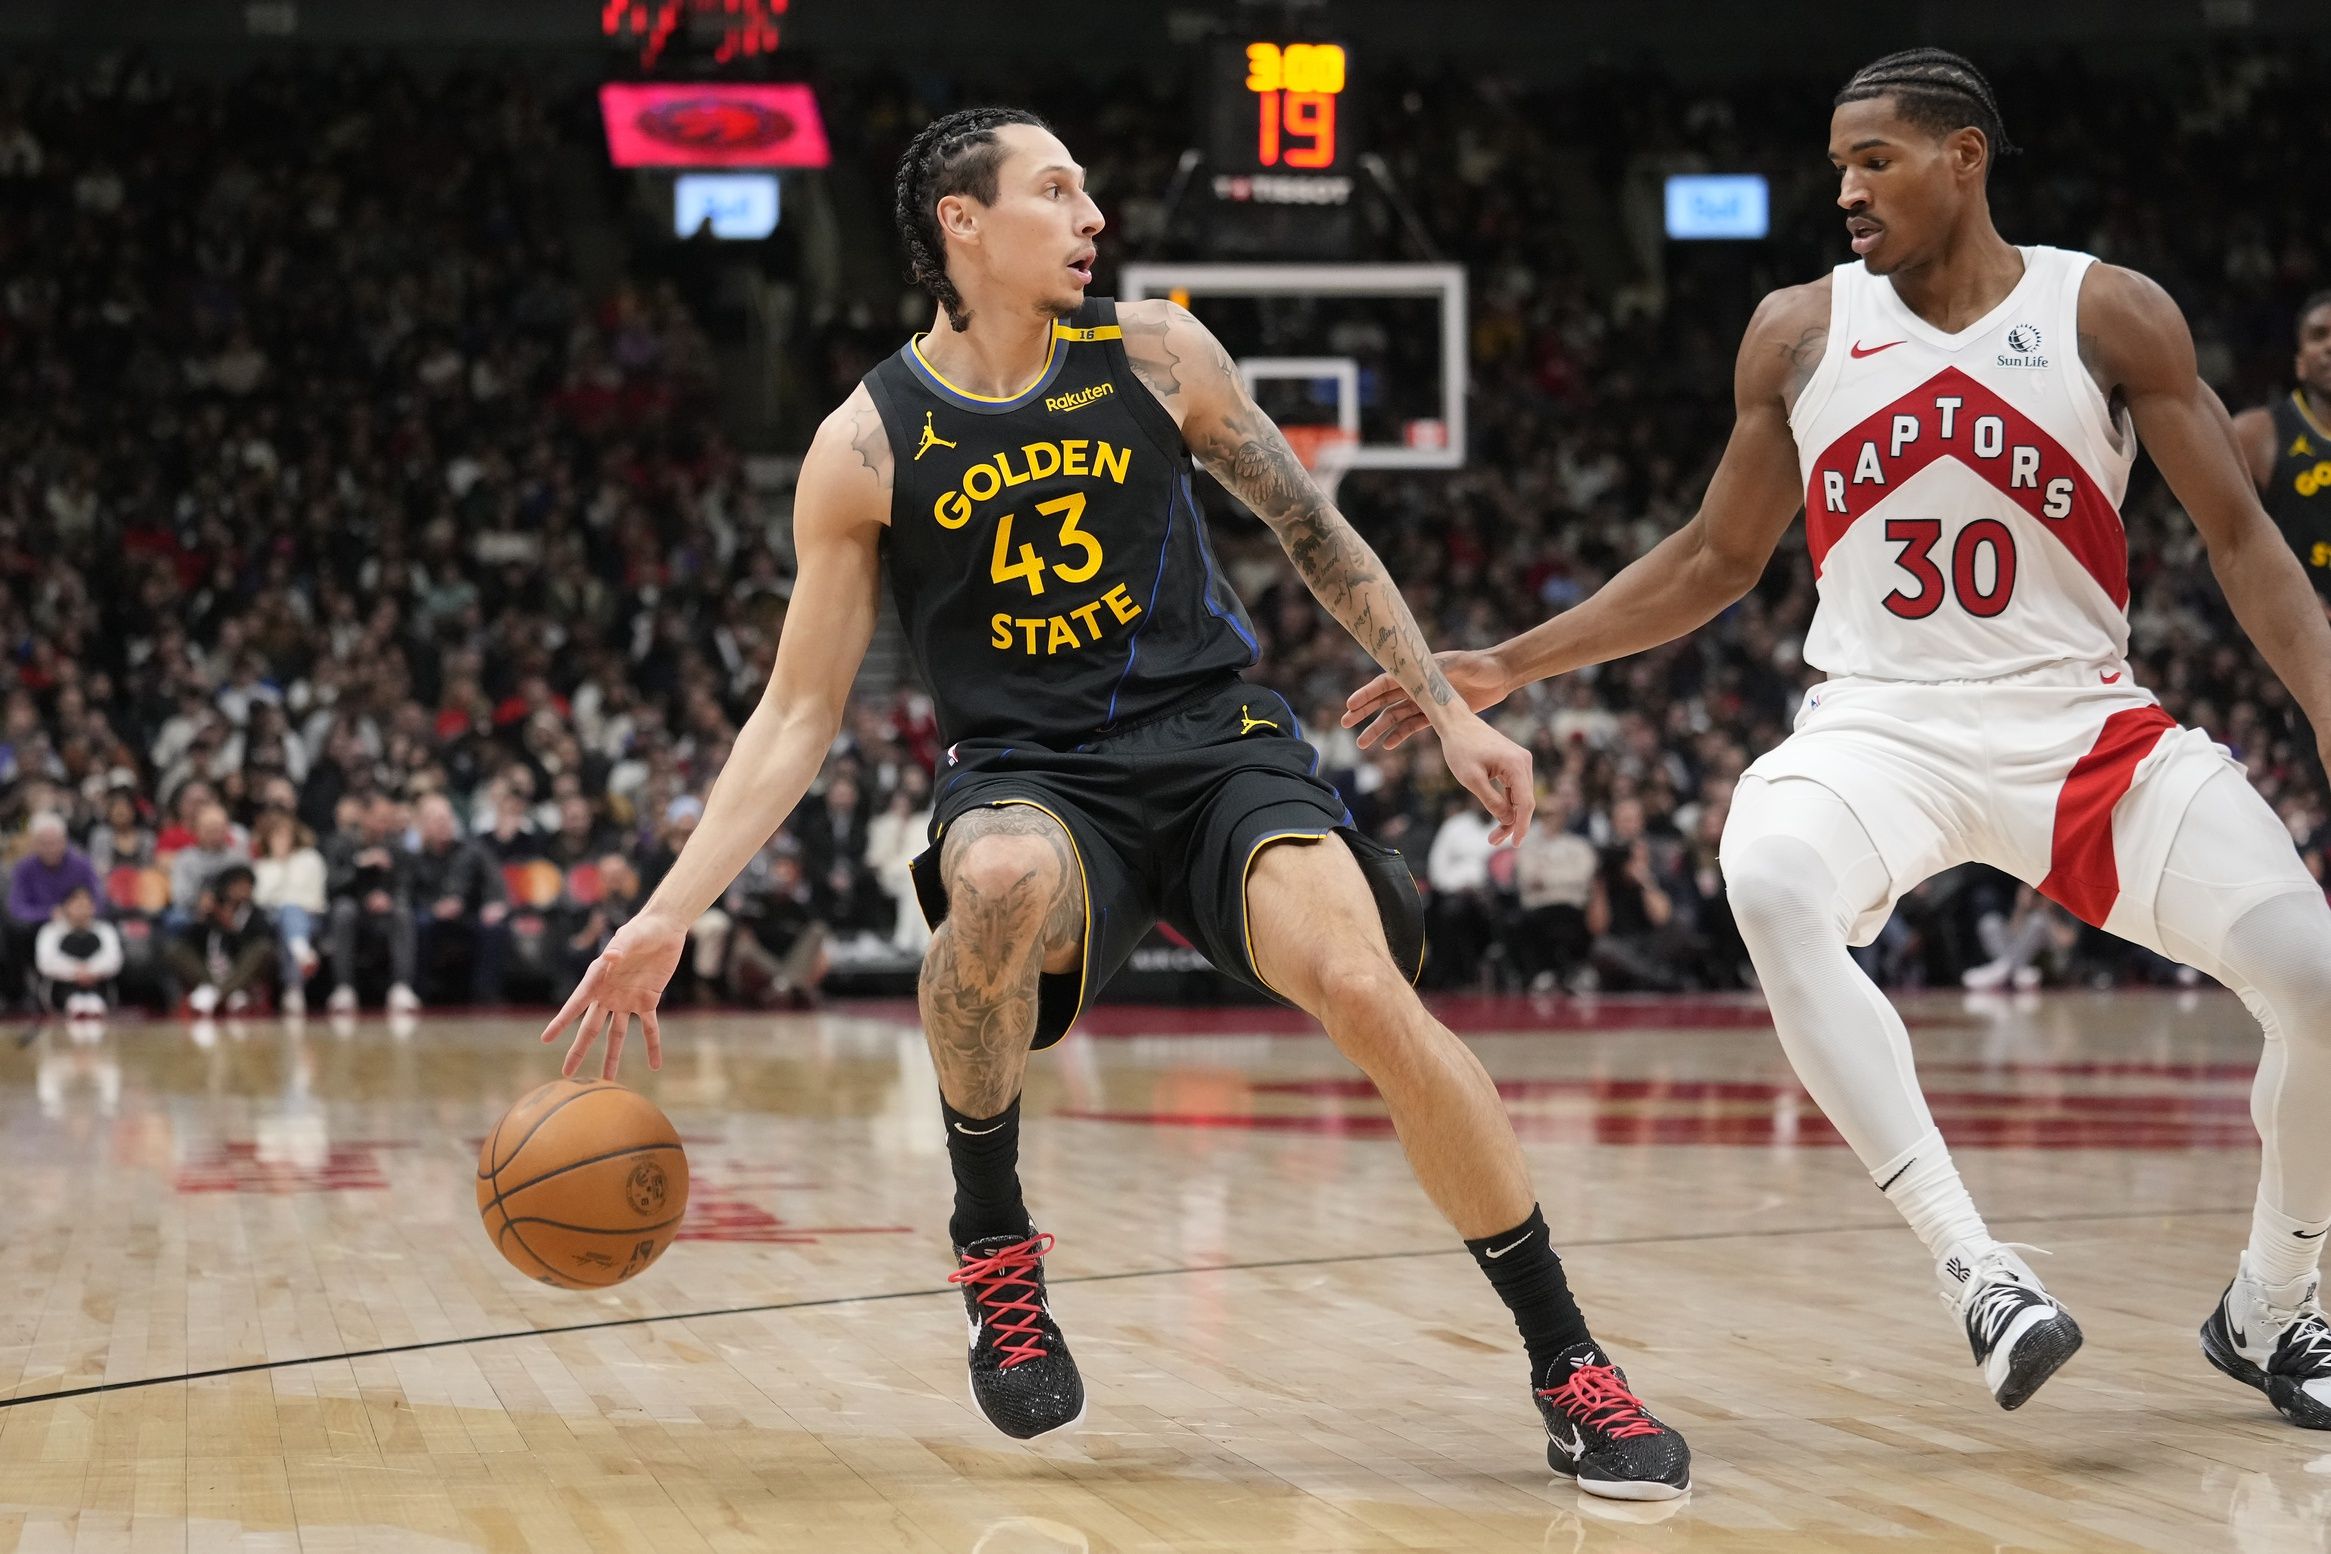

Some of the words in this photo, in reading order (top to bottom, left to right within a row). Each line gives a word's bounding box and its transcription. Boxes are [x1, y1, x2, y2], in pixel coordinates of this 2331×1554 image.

[1259, 90, 1336, 168] 19
[1079, 330, 1095, 339] 16
[1997, 355, 2022, 367] Sun
[2024, 355, 2049, 368] Life
[1045, 382, 1114, 413] Rakuten
[933, 439, 1133, 531] GOLDEN
[1822, 396, 2075, 520] RAPTORS
[990, 491, 1105, 597] 43
[1880, 518, 2017, 621] 30
[991, 582, 1143, 655] STATE
